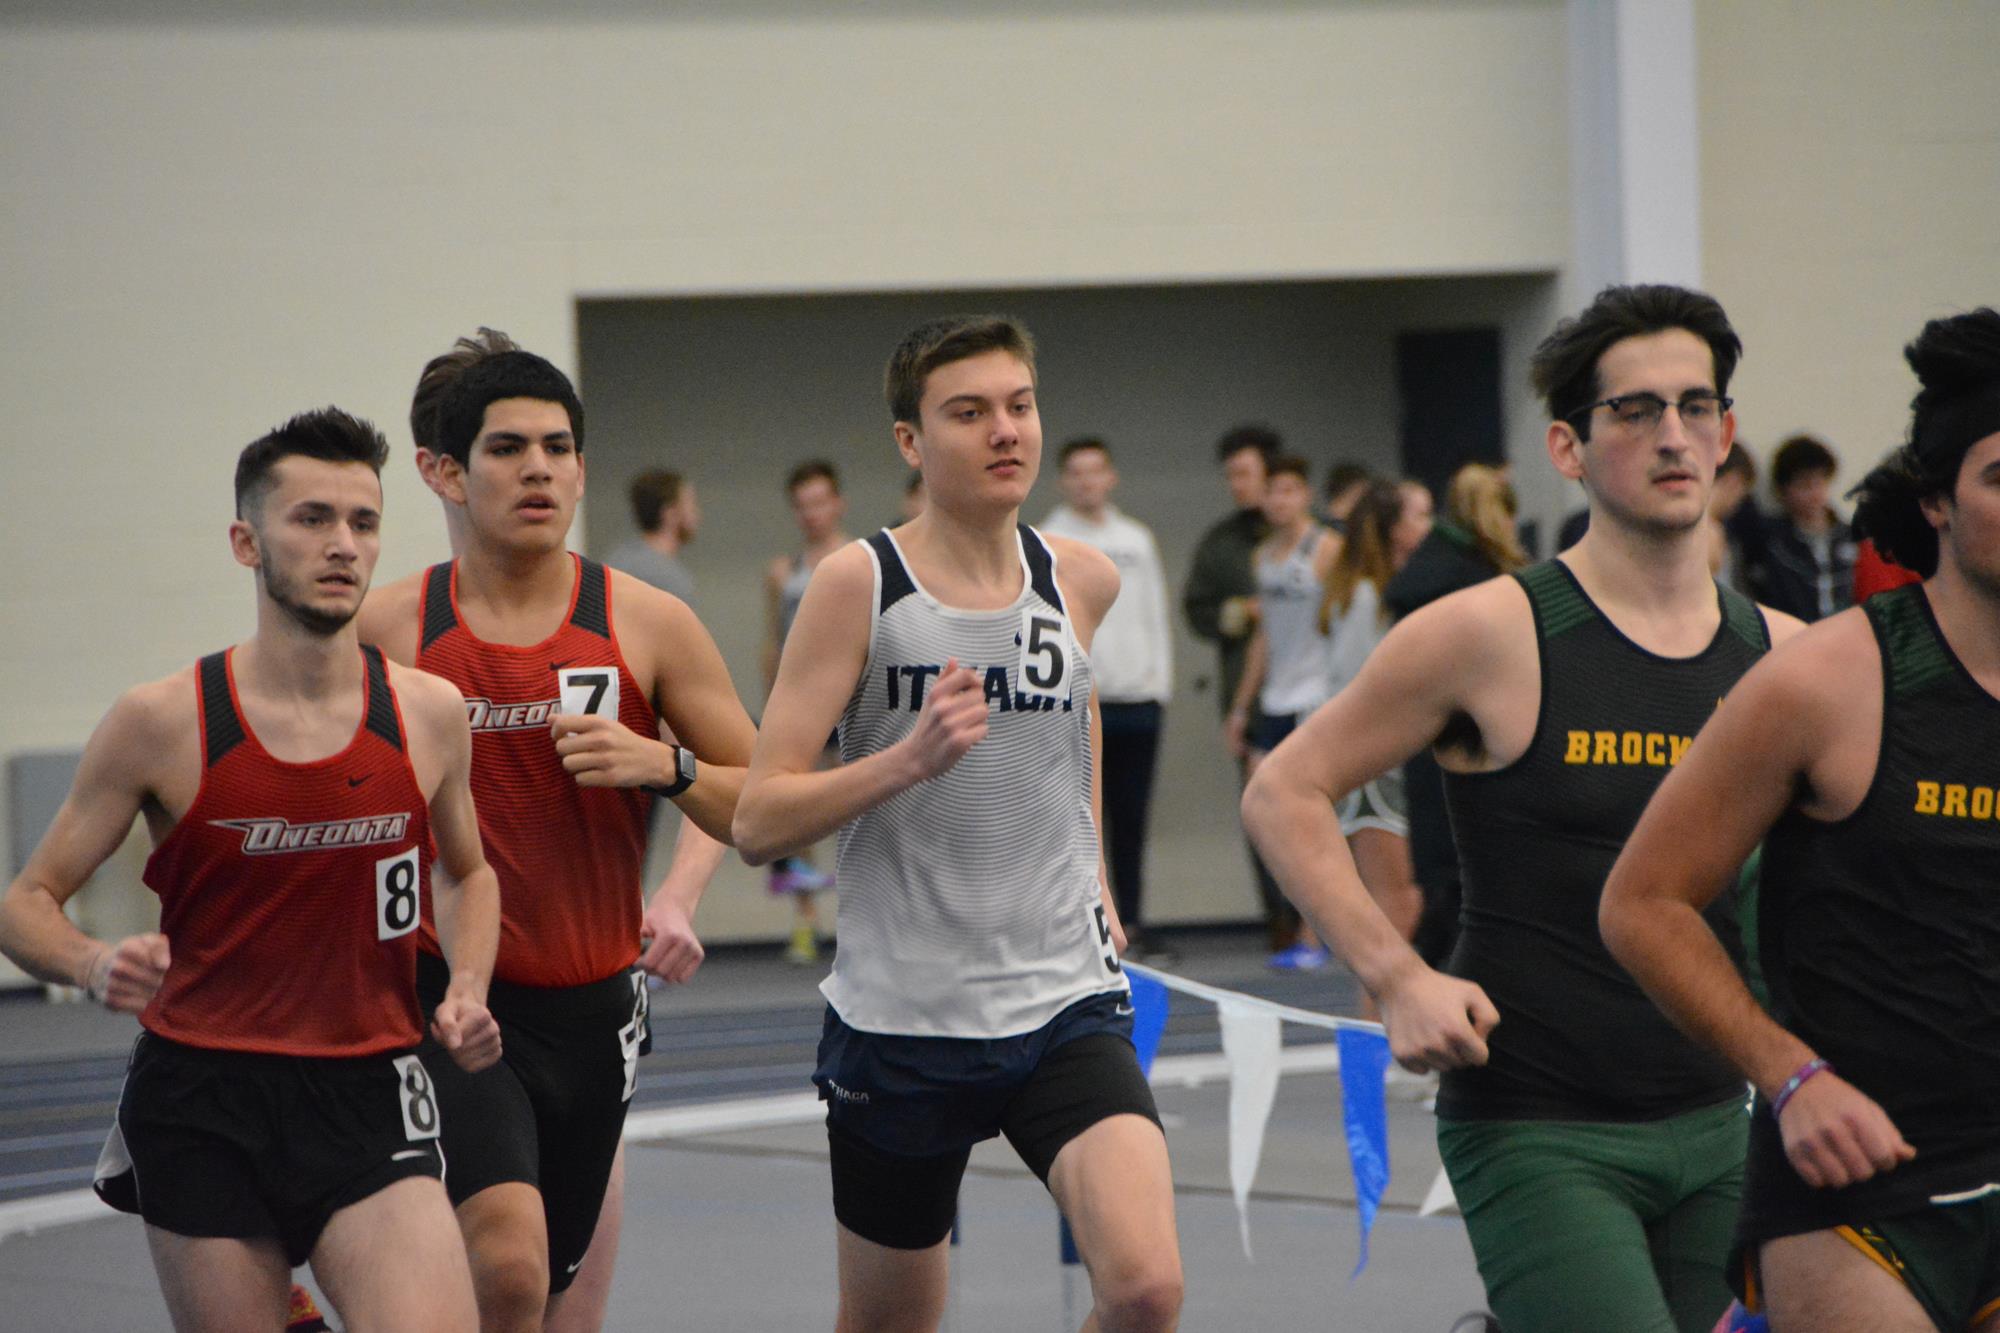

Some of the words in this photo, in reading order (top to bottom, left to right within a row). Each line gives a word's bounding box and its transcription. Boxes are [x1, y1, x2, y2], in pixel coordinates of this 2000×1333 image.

[1025, 616, 1064, 689] 5
[567, 674, 609, 714] 7
[886, 664, 1072, 712] ITA
[1914, 781, 2000, 821] BRO
[242, 814, 405, 853] ONEONTA
[385, 859, 416, 930] 8
[406, 1062, 436, 1132] 8
